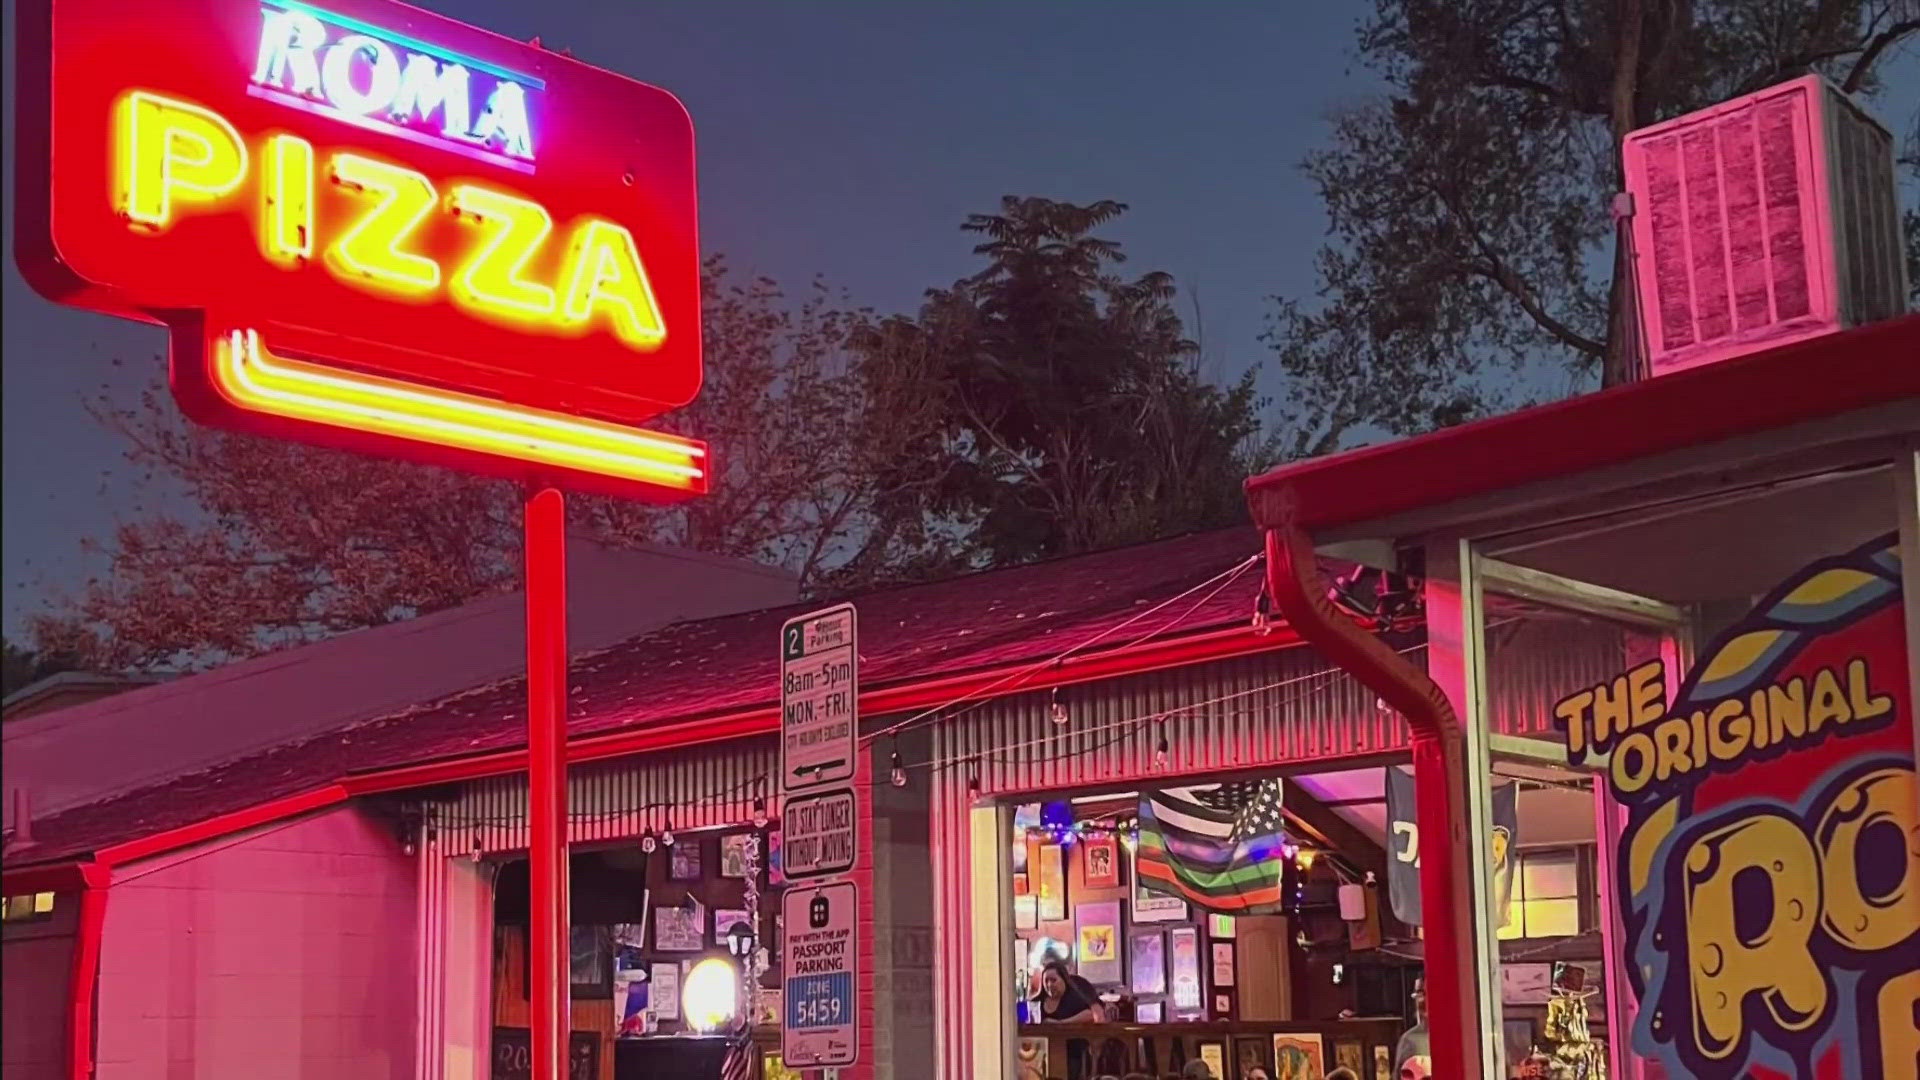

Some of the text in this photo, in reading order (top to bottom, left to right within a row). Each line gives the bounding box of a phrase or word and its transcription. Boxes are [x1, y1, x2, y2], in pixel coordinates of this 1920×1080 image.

[250, 3, 535, 161] ROMA
[116, 90, 668, 347] PIZZA
[789, 628, 799, 655] 2
[810, 630, 843, 647] Parking
[786, 662, 850, 695] 8am-5pm
[1555, 660, 1666, 756] THE
[1610, 658, 1892, 793] ORIGINAL
[788, 799, 850, 837] TO STAY LONGER
[787, 831, 851, 869] WITHOUT MOVING
[792, 939, 847, 960] PASSPORT
[803, 932, 820, 942] WITH
[821, 930, 834, 940] THE
[835, 928, 850, 938] APP
[795, 956, 844, 975] PARKING
[807, 980, 831, 996] ZONE
[797, 997, 841, 1024] 5459
